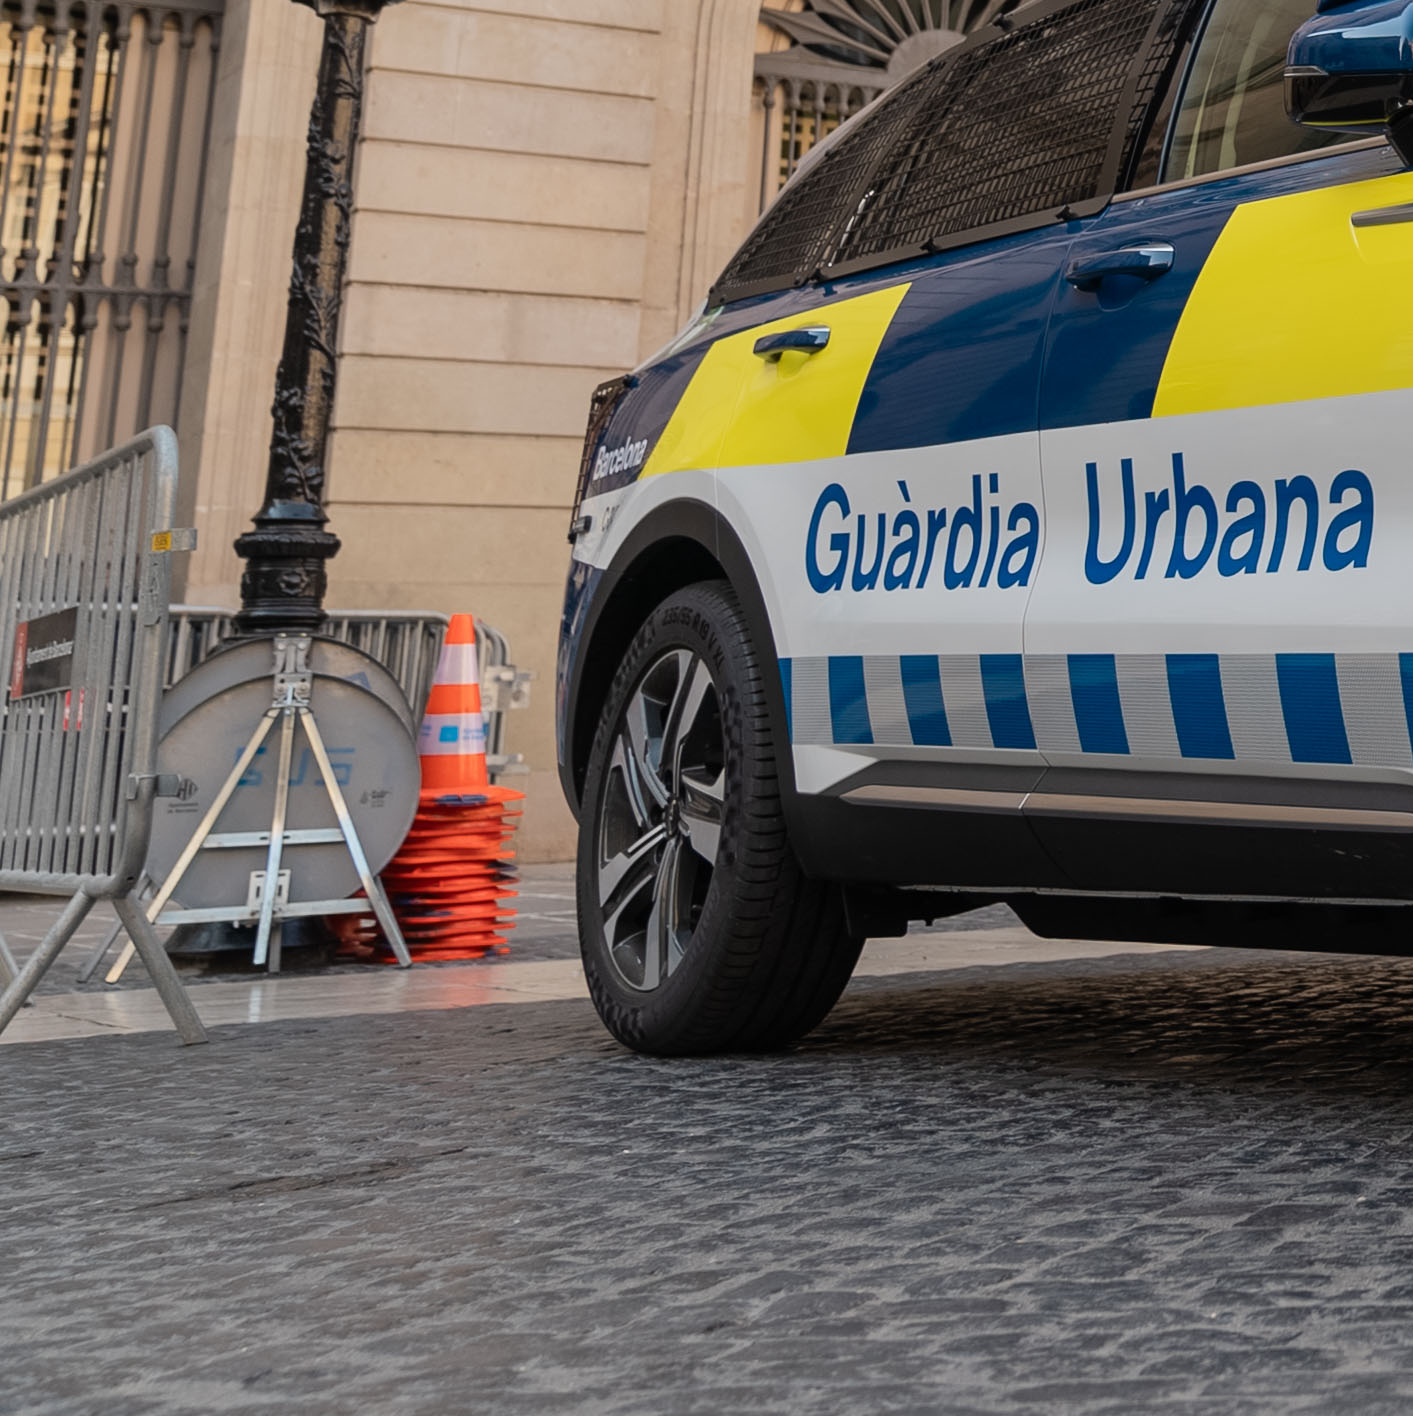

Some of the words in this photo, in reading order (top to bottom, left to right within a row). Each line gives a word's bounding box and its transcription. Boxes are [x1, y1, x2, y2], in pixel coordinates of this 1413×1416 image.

[592, 435, 648, 481] Barcelona
[805, 473, 1040, 594] Guàrdia
[1084, 452, 1374, 585] Urbana
